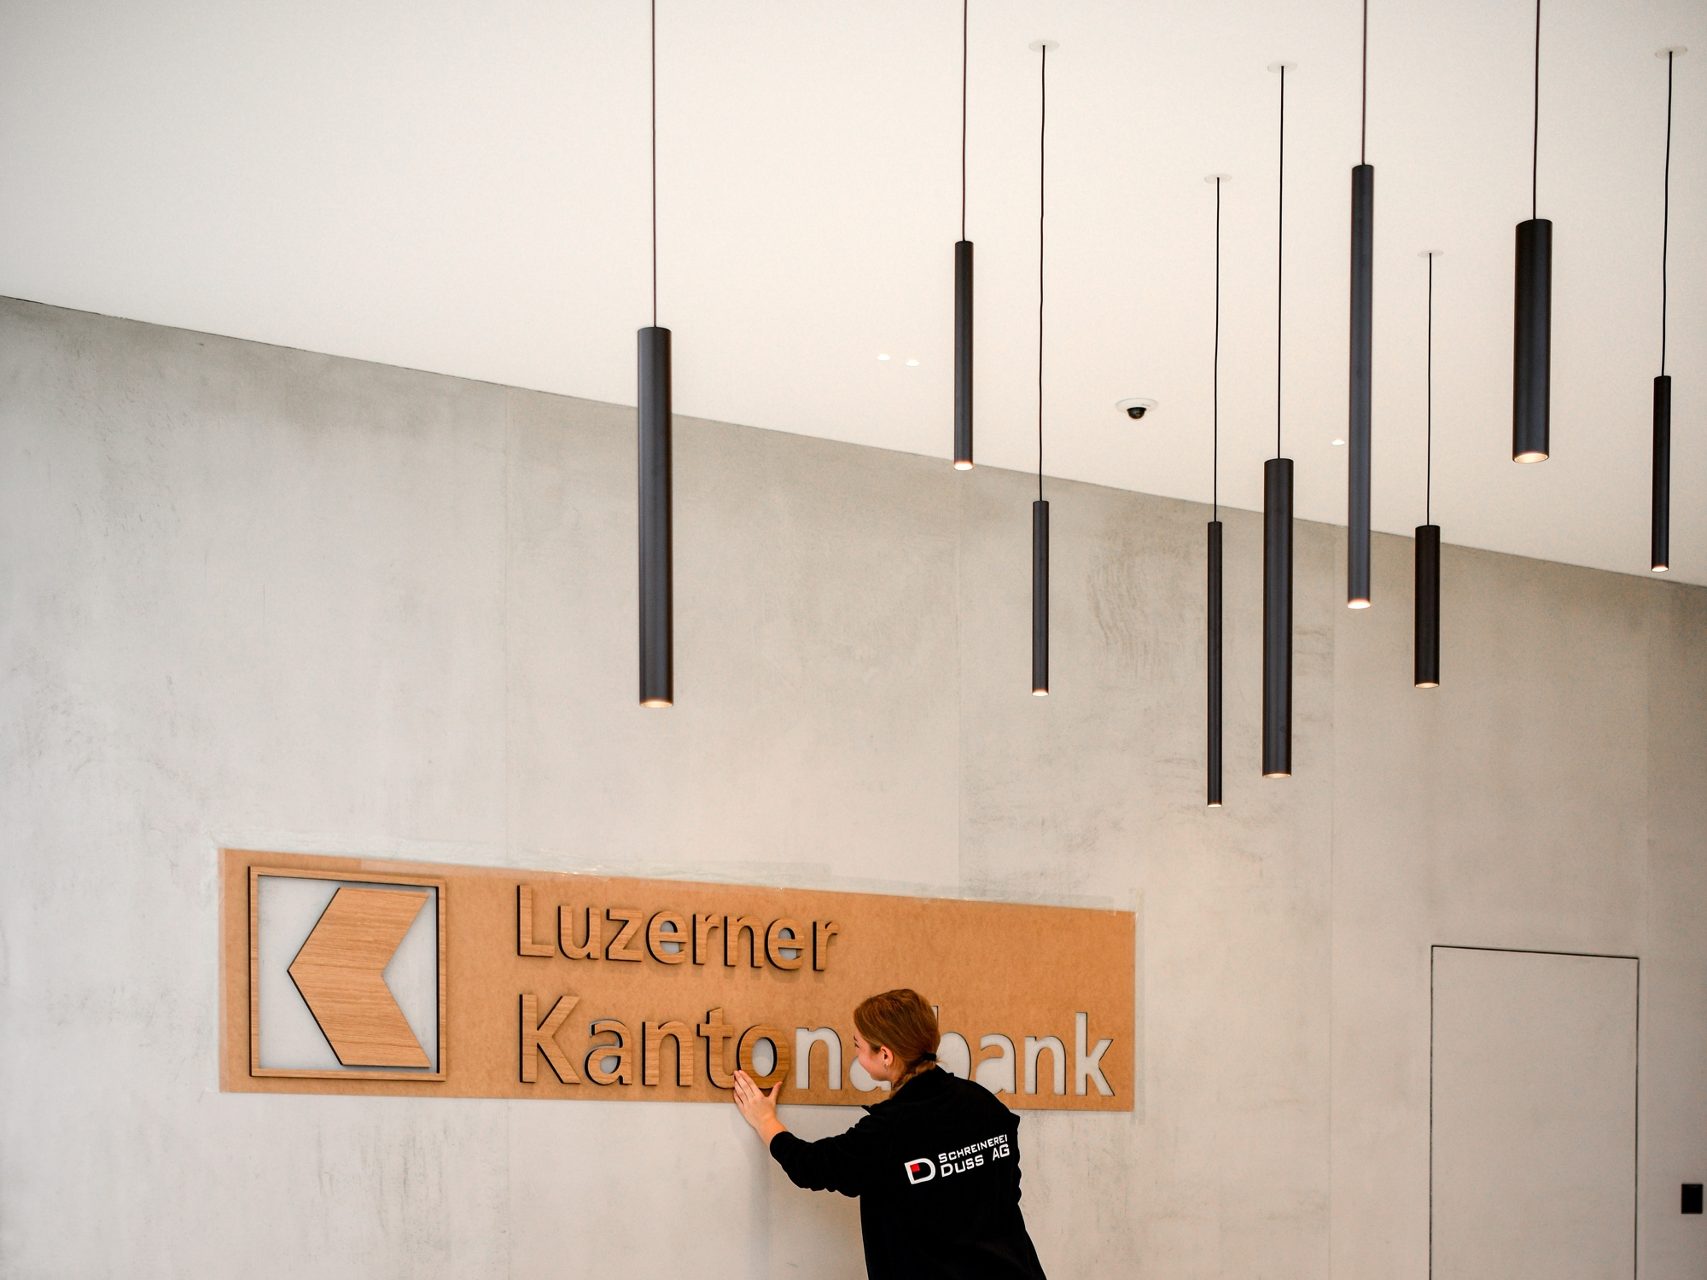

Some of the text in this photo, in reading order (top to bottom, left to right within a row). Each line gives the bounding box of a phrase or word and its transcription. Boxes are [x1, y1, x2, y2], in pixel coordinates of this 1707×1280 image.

[516, 884, 840, 972] Luzerner
[518, 993, 1116, 1097] Kantonank
[938, 1134, 1008, 1163] SCHREINEREI
[940, 1143, 1011, 1178] DUSS AG
